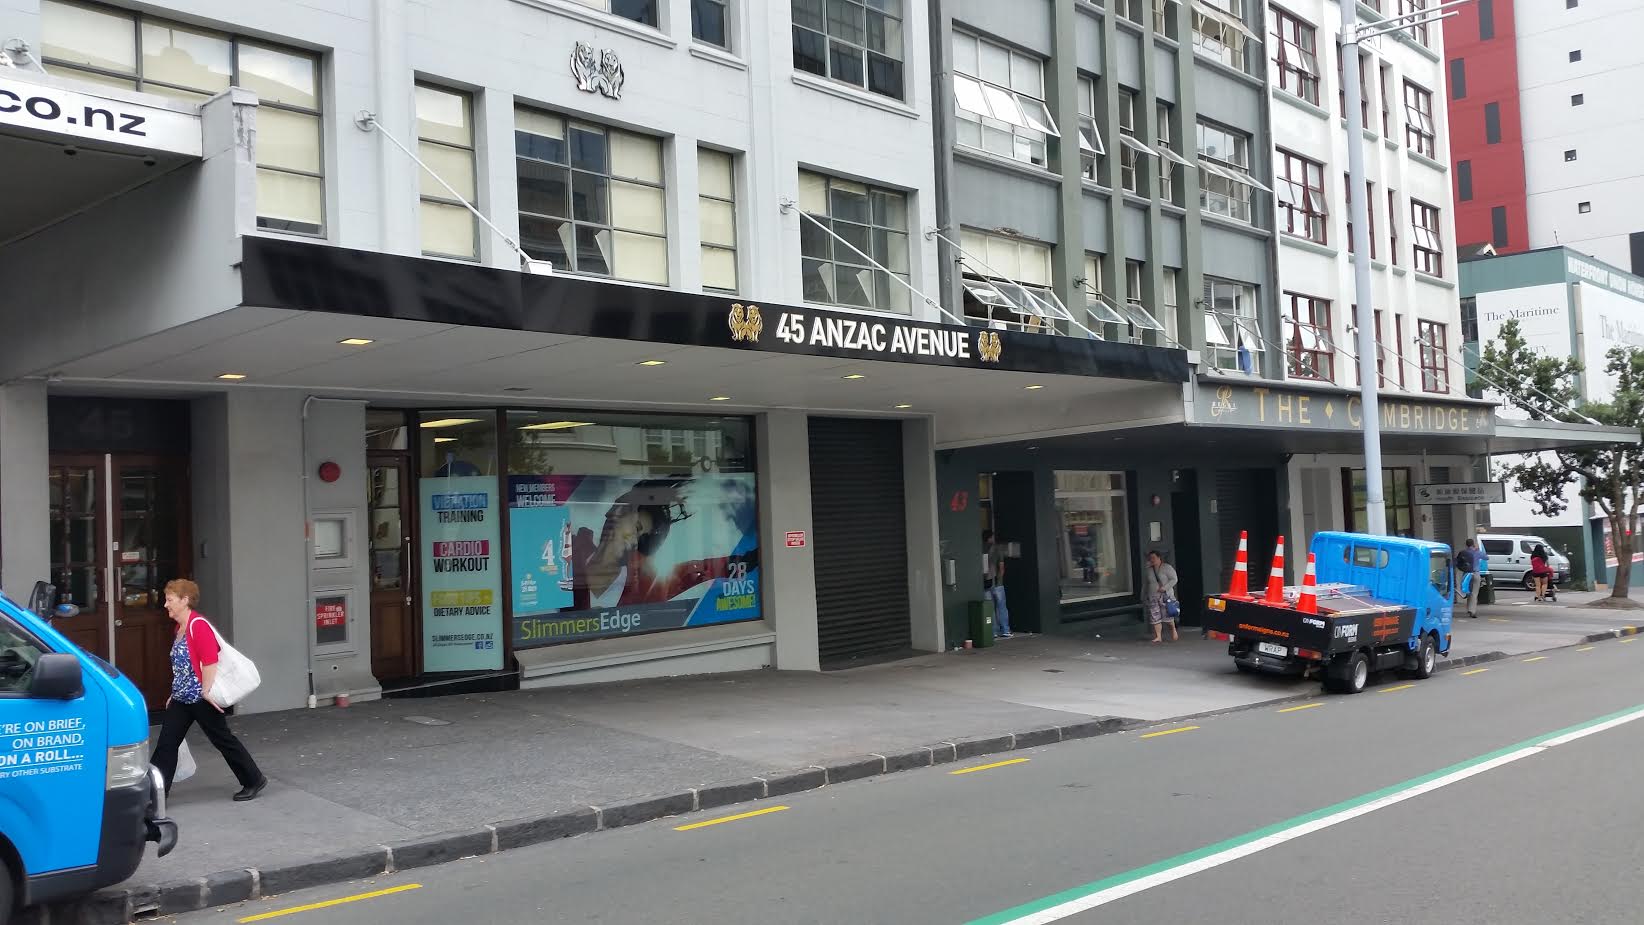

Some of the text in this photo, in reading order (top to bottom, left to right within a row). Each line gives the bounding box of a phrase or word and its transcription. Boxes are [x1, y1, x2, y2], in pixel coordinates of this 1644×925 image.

[1484, 307, 1560, 321] The Maritime
[775, 312, 970, 358] 45 ANZAC AVENUE
[1253, 387, 1311, 424] THE
[1347, 396, 1470, 431] CMBRIDGE
[516, 494, 556, 507] WELCOME
[437, 510, 484, 523] TRAINING
[440, 541, 483, 556] CARDIO
[541, 539, 555, 566] 4
[433, 557, 490, 572] WORKOUT
[728, 562, 747, 581] 28
[722, 580, 755, 597] DAYS
[433, 606, 491, 617] DIETARY ADVICE
[520, 609, 641, 640] SlimmersEdge
[0, 718, 85, 735] 'RE ON BRIEF,
[12, 733, 84, 749] ON BRAND,
[21, 752, 31, 764] A
[35, 749, 83, 762] ROLL...
[12, 768, 38, 777] OTHER
[40, 764, 83, 774] SUBSTRATE
